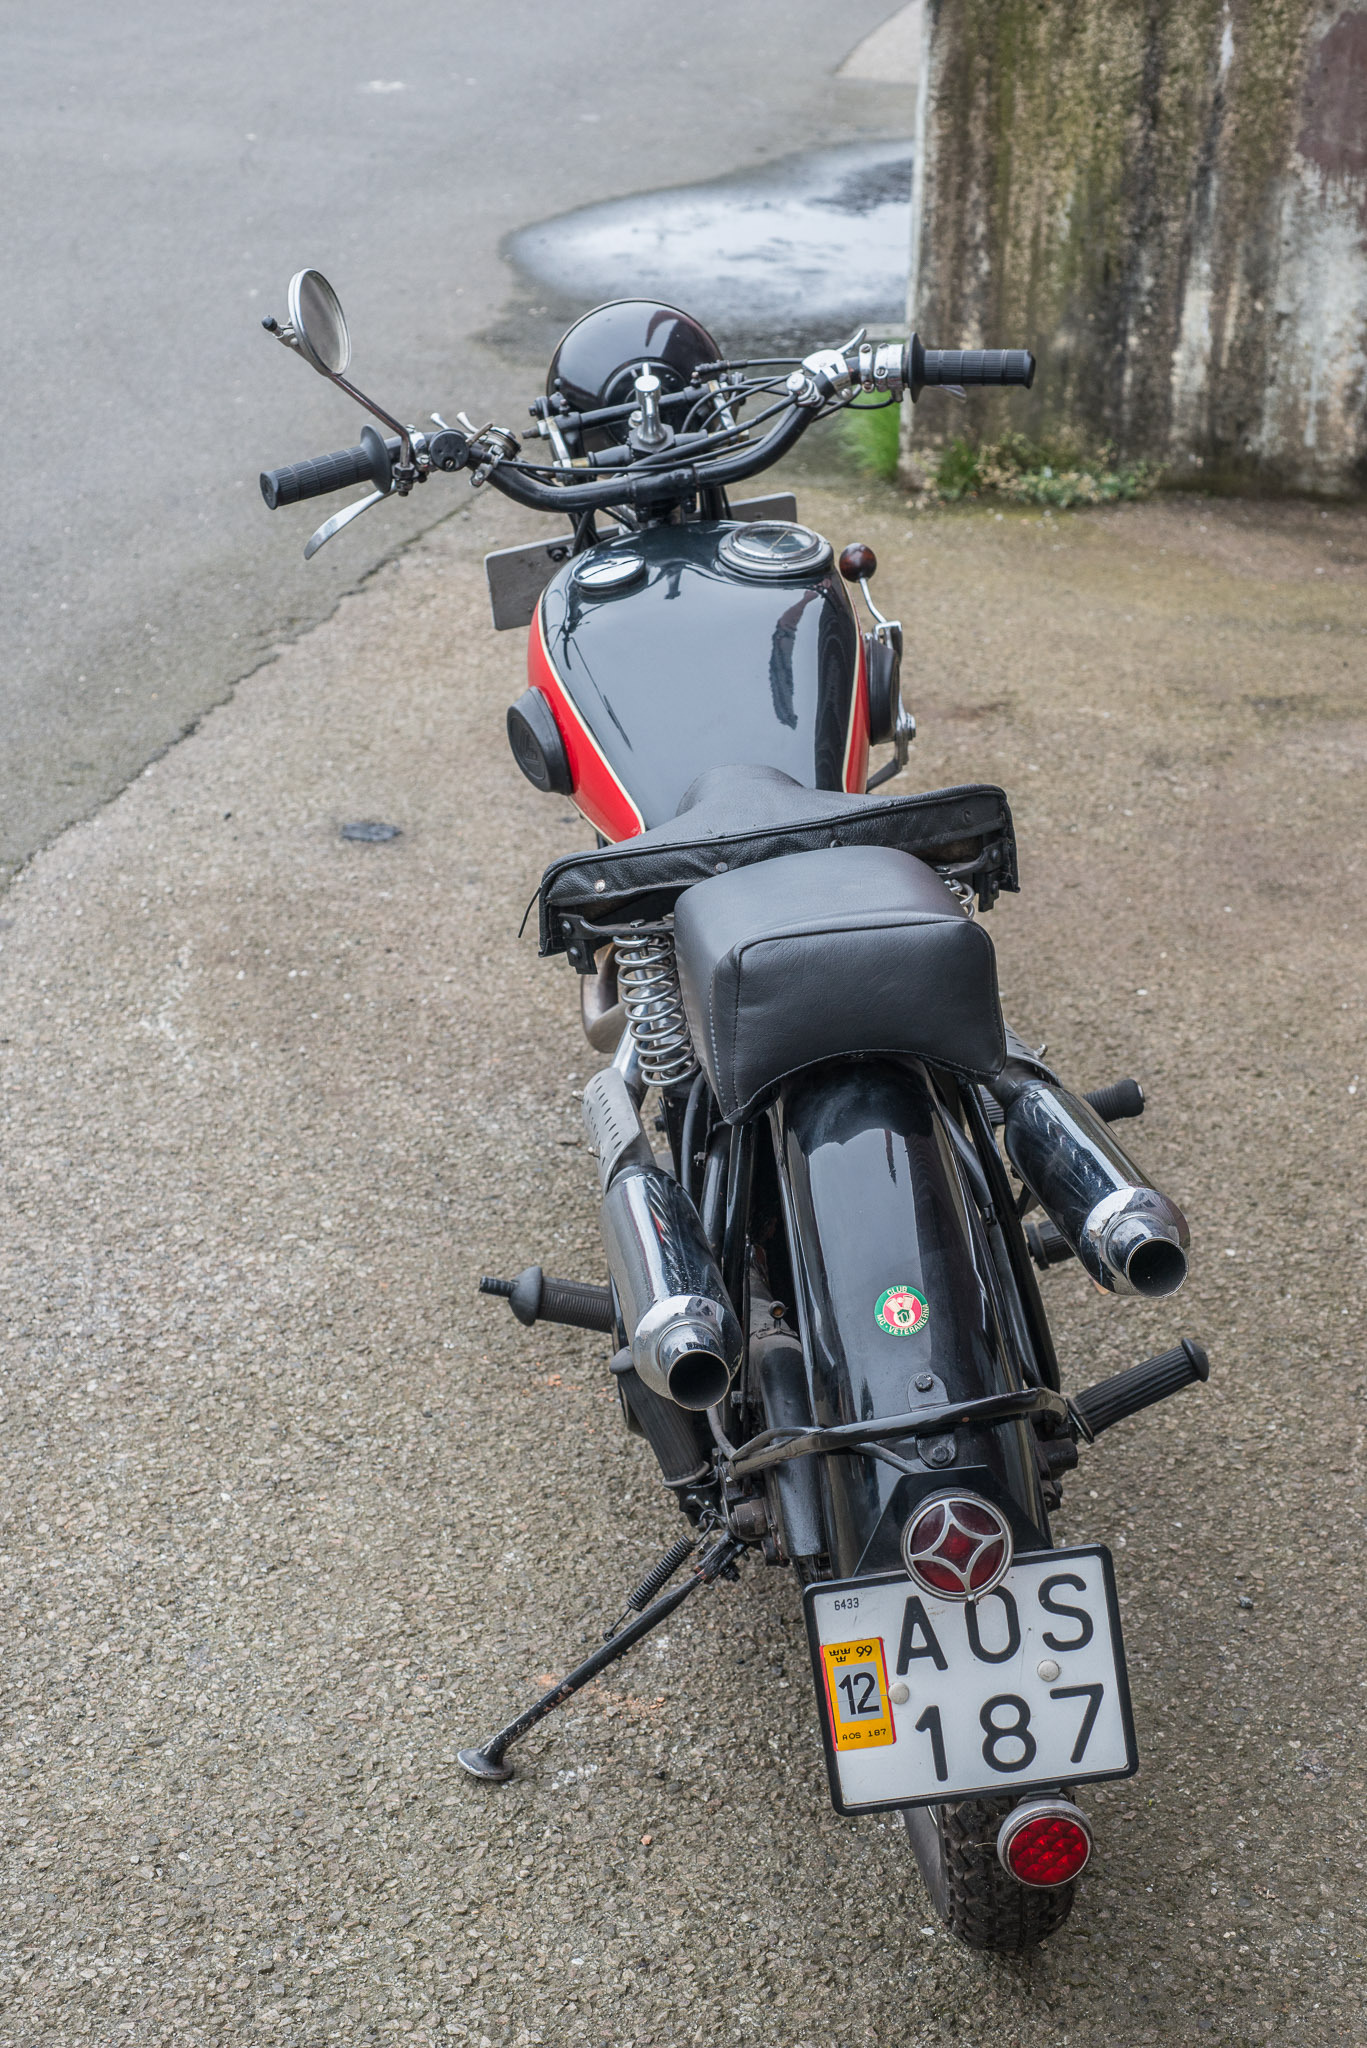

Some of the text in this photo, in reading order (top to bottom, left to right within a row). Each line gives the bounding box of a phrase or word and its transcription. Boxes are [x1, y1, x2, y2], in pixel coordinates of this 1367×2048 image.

[887, 1286, 908, 1297] CLUB
[876, 1304, 929, 1335] MC VETERANERNA
[834, 1597, 860, 1611] 6433
[896, 1573, 1094, 1676] AOS
[855, 1645, 873, 1658] 99
[838, 1671, 880, 1716] 12
[842, 1728, 887, 1740] AOS 187
[914, 1683, 1104, 1781] 187
